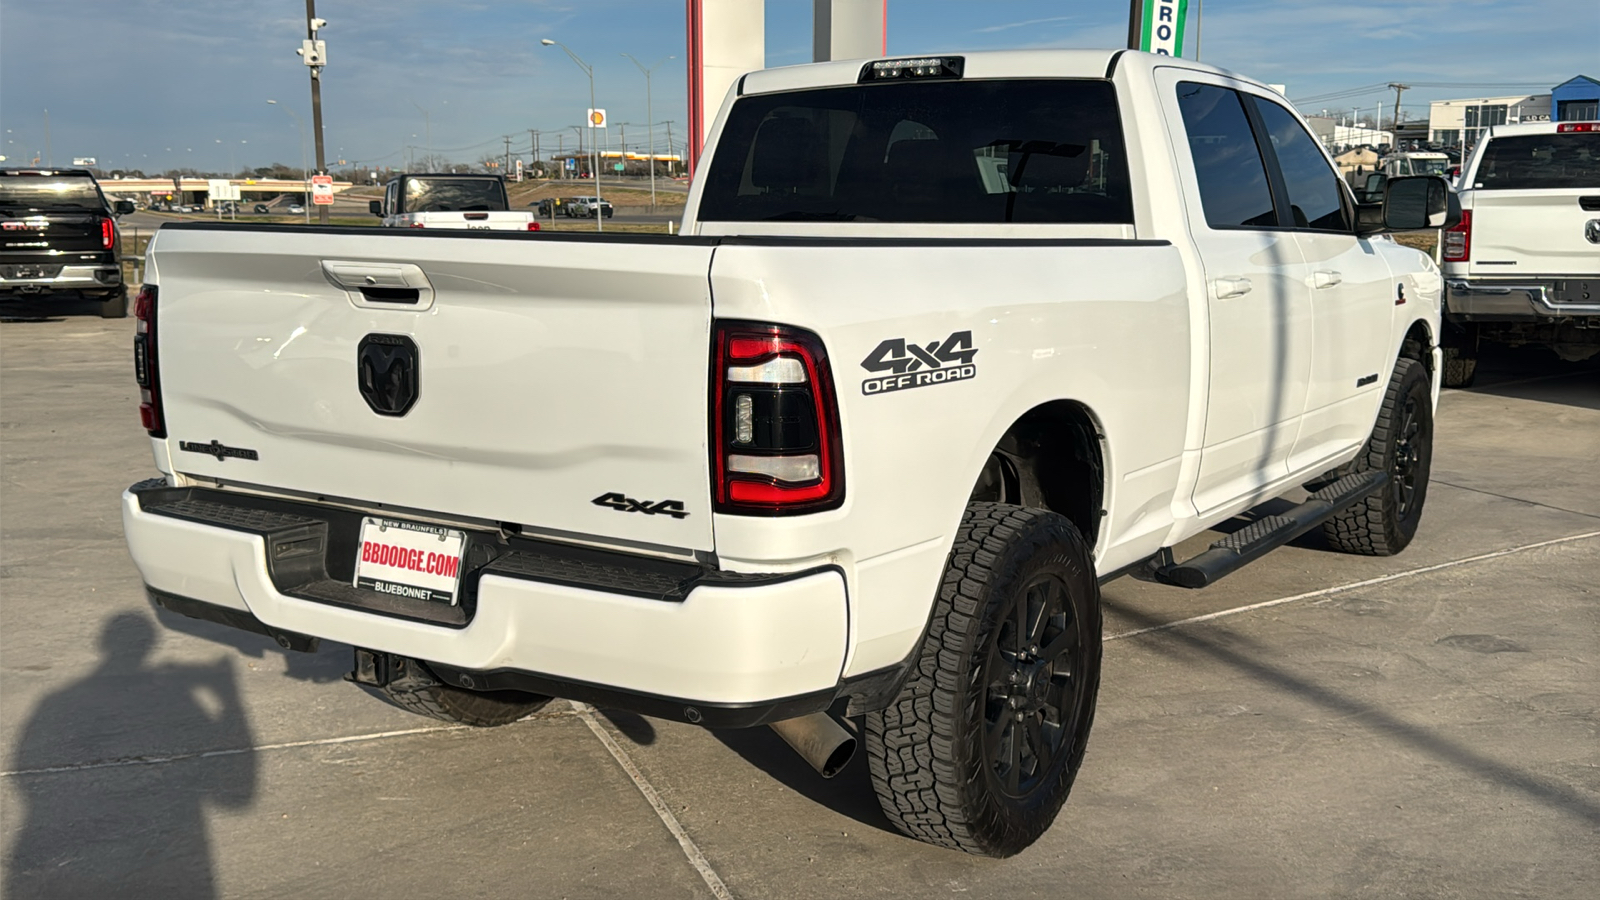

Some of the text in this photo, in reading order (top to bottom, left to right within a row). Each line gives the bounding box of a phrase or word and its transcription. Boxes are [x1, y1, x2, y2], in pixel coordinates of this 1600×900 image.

[1157, 0, 1173, 41] RO
[864, 366, 974, 393] OFF ROAD
[383, 520, 444, 534] NEW BRAUNFELS
[362, 541, 459, 578] BBDODGE.COM
[375, 581, 432, 600] BLUEBONNET
